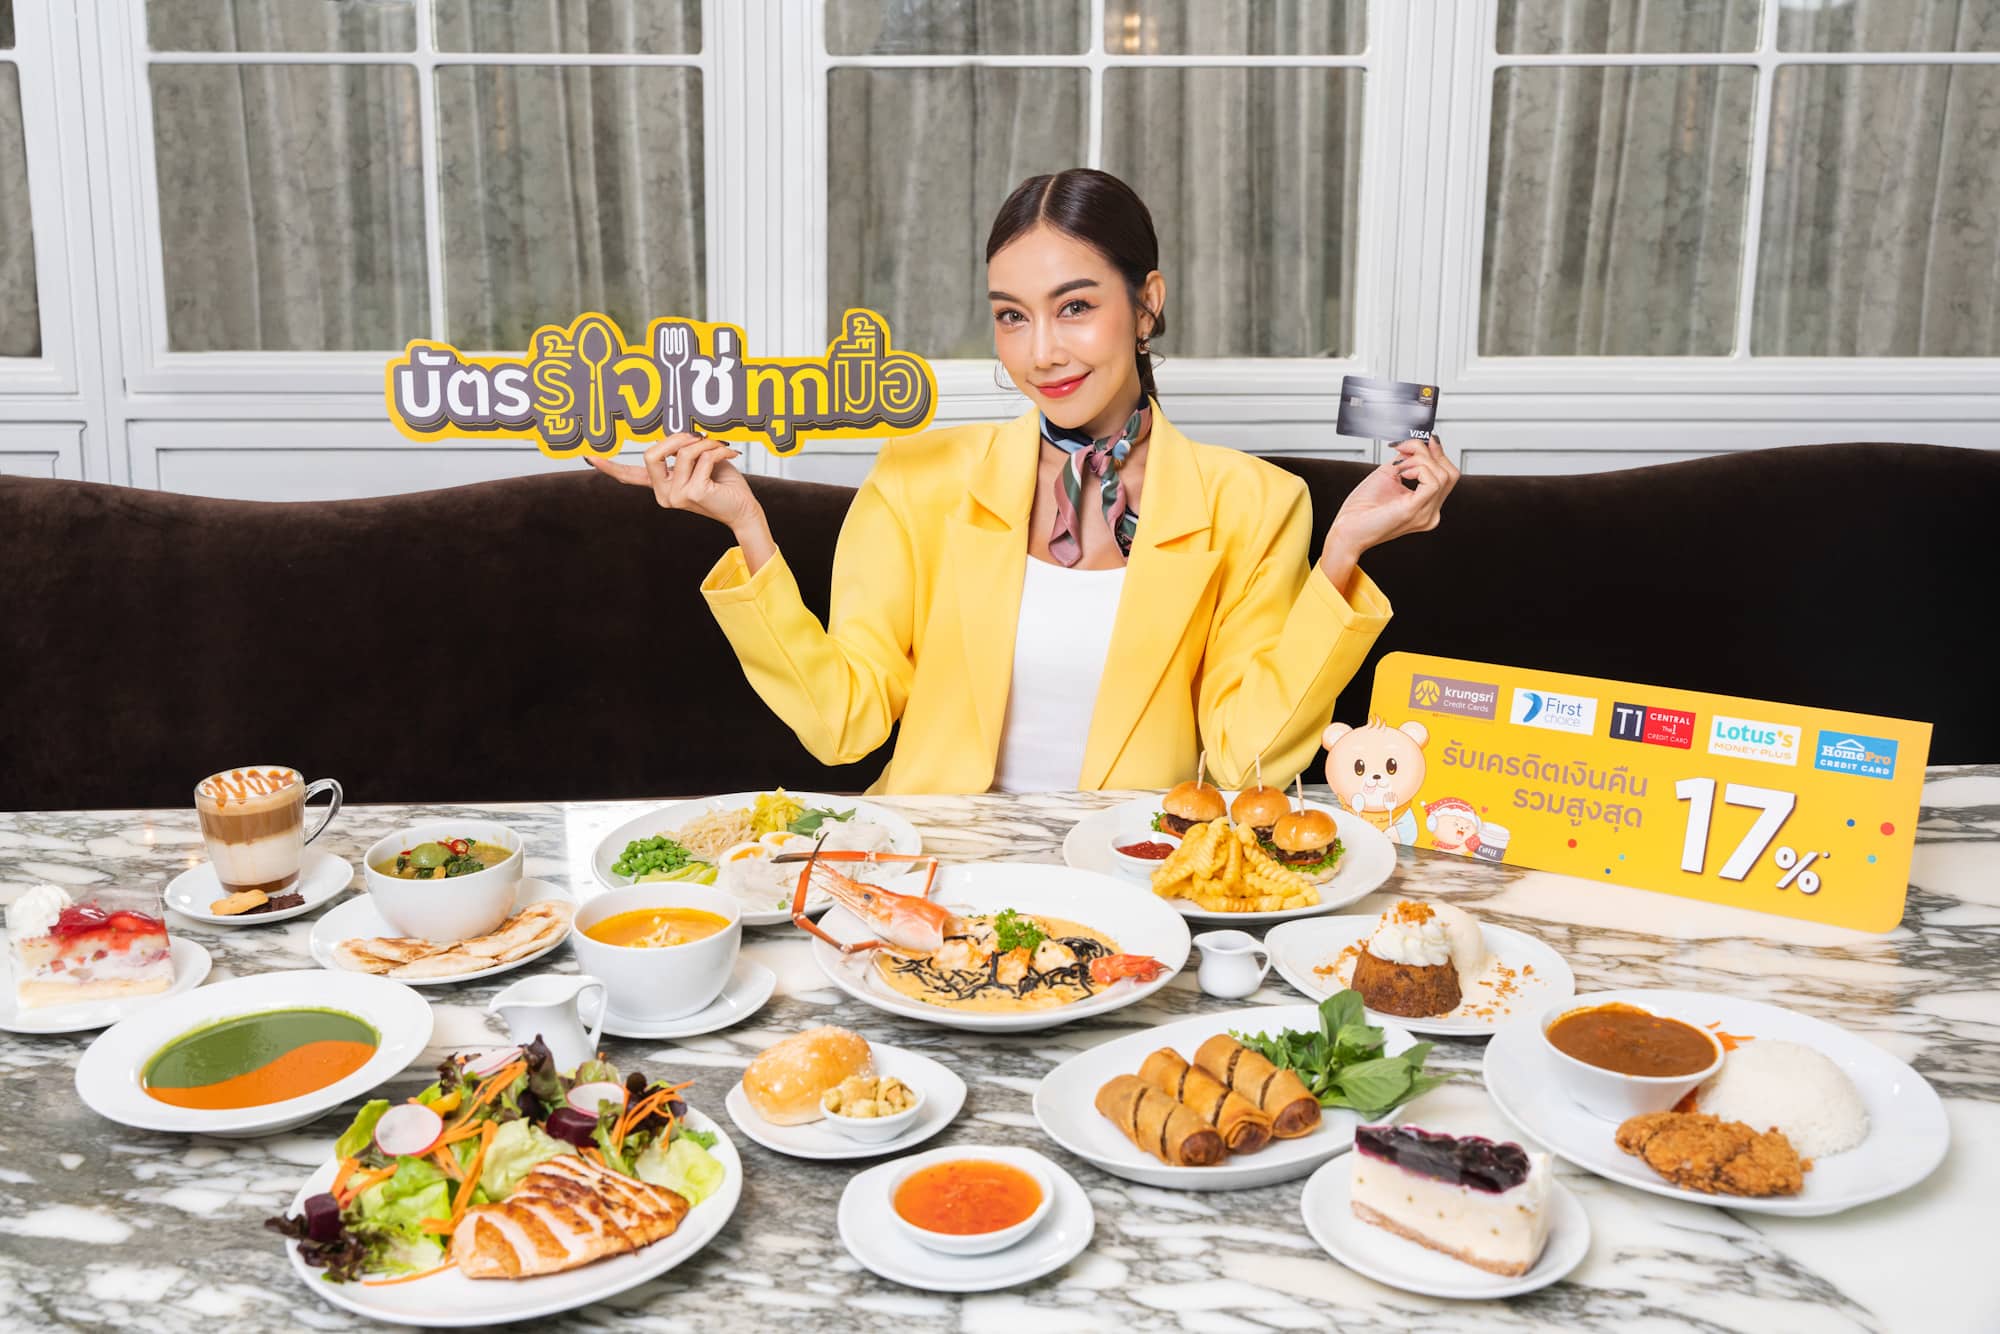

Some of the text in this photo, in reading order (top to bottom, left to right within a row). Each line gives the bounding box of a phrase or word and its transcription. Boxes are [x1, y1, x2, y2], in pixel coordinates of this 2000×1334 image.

[1409, 429, 1430, 440] VISA
[1444, 686, 1495, 703] krungsri
[1443, 699, 1489, 713] Credit Cards
[1545, 697, 1583, 718] First
[1543, 714, 1582, 728] choice
[1616, 707, 1643, 737] T1
[1650, 712, 1690, 726] CENTRAL
[1647, 733, 1689, 745] CREDIT CARD
[1716, 721, 1793, 748] Lotus's
[1714, 741, 1792, 760] MONEY PLUS
[1821, 744, 1892, 766] HomePro
[1442, 739, 1649, 798] รับเครดิตเงินคืน
[1819, 759, 1890, 776] CREDIT CARD
[1512, 787, 1643, 833] รวมสูงสุด
